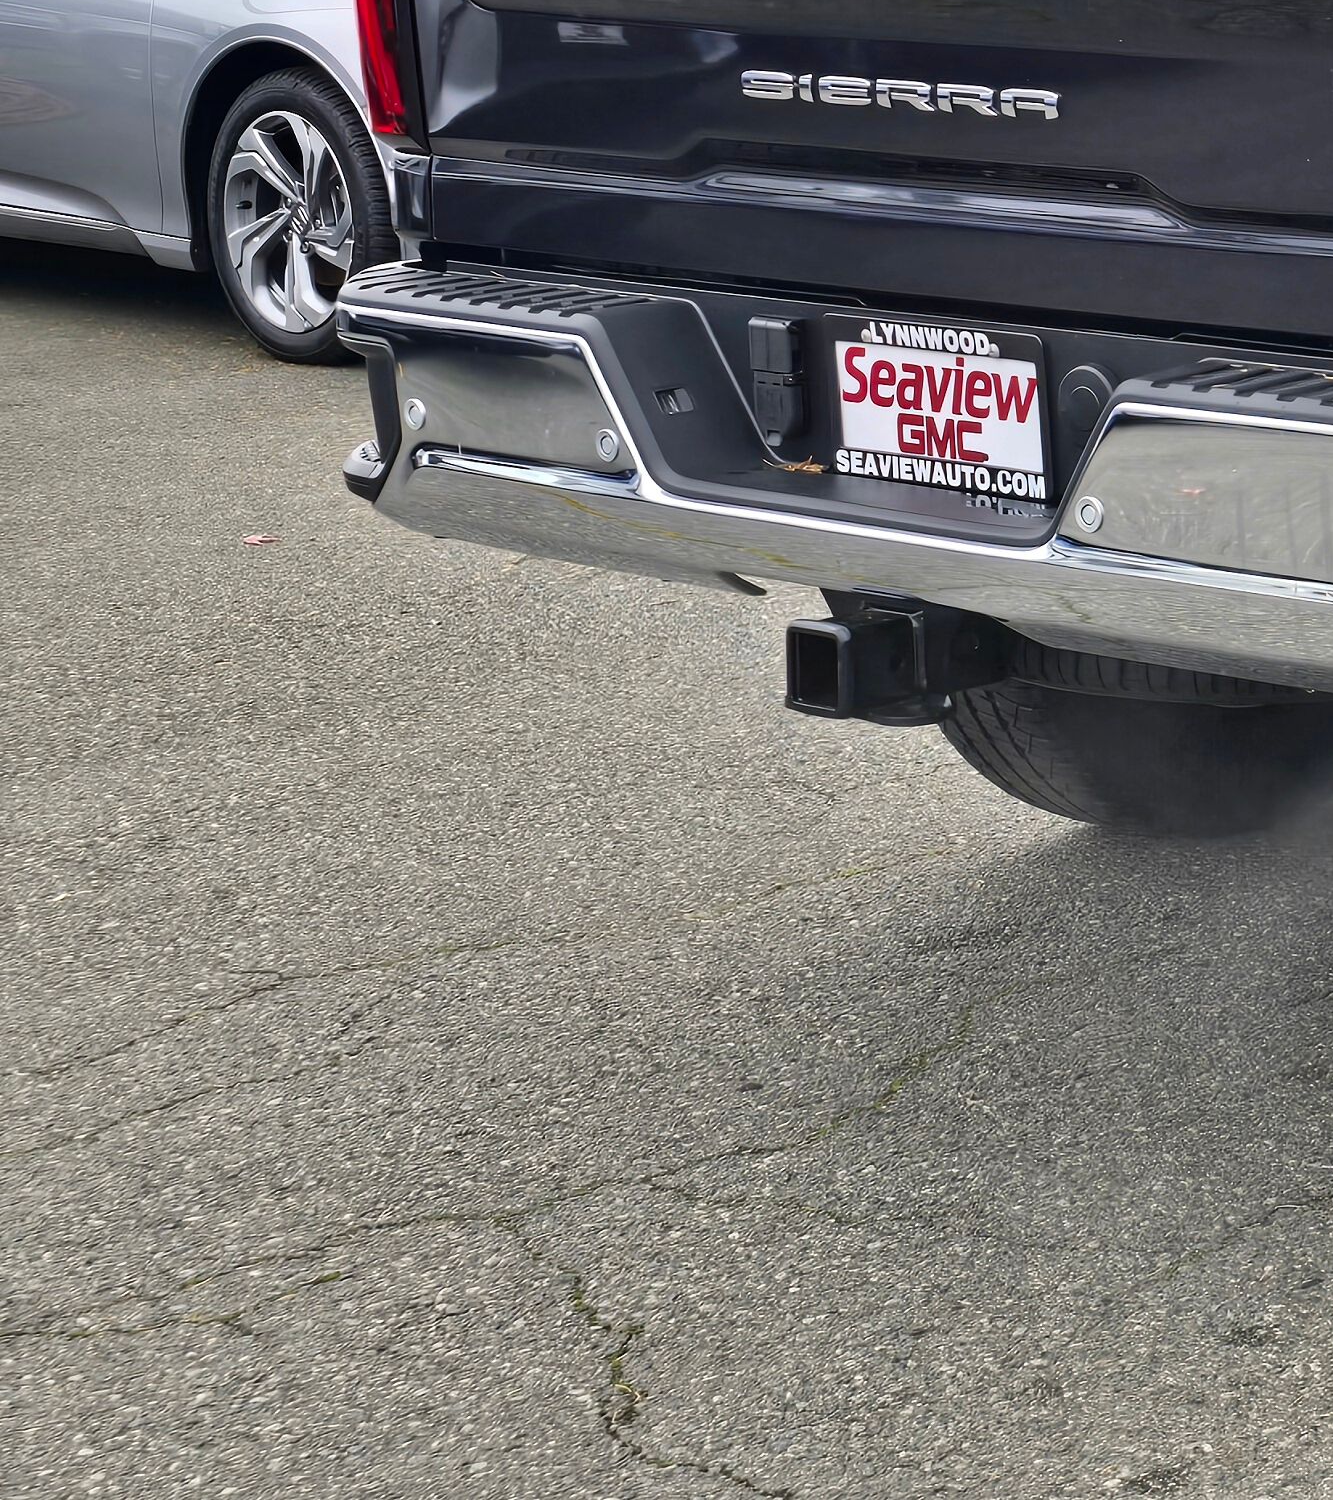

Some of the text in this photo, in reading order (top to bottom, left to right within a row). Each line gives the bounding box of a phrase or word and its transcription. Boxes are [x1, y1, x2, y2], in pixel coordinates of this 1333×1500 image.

[740, 69, 1060, 120] SIERRA
[868, 321, 991, 357] LYNNWOOD
[841, 346, 1038, 424] Seaview
[896, 412, 989, 463] GMC
[836, 449, 1047, 500] SEAVIEWAUTO.COM
